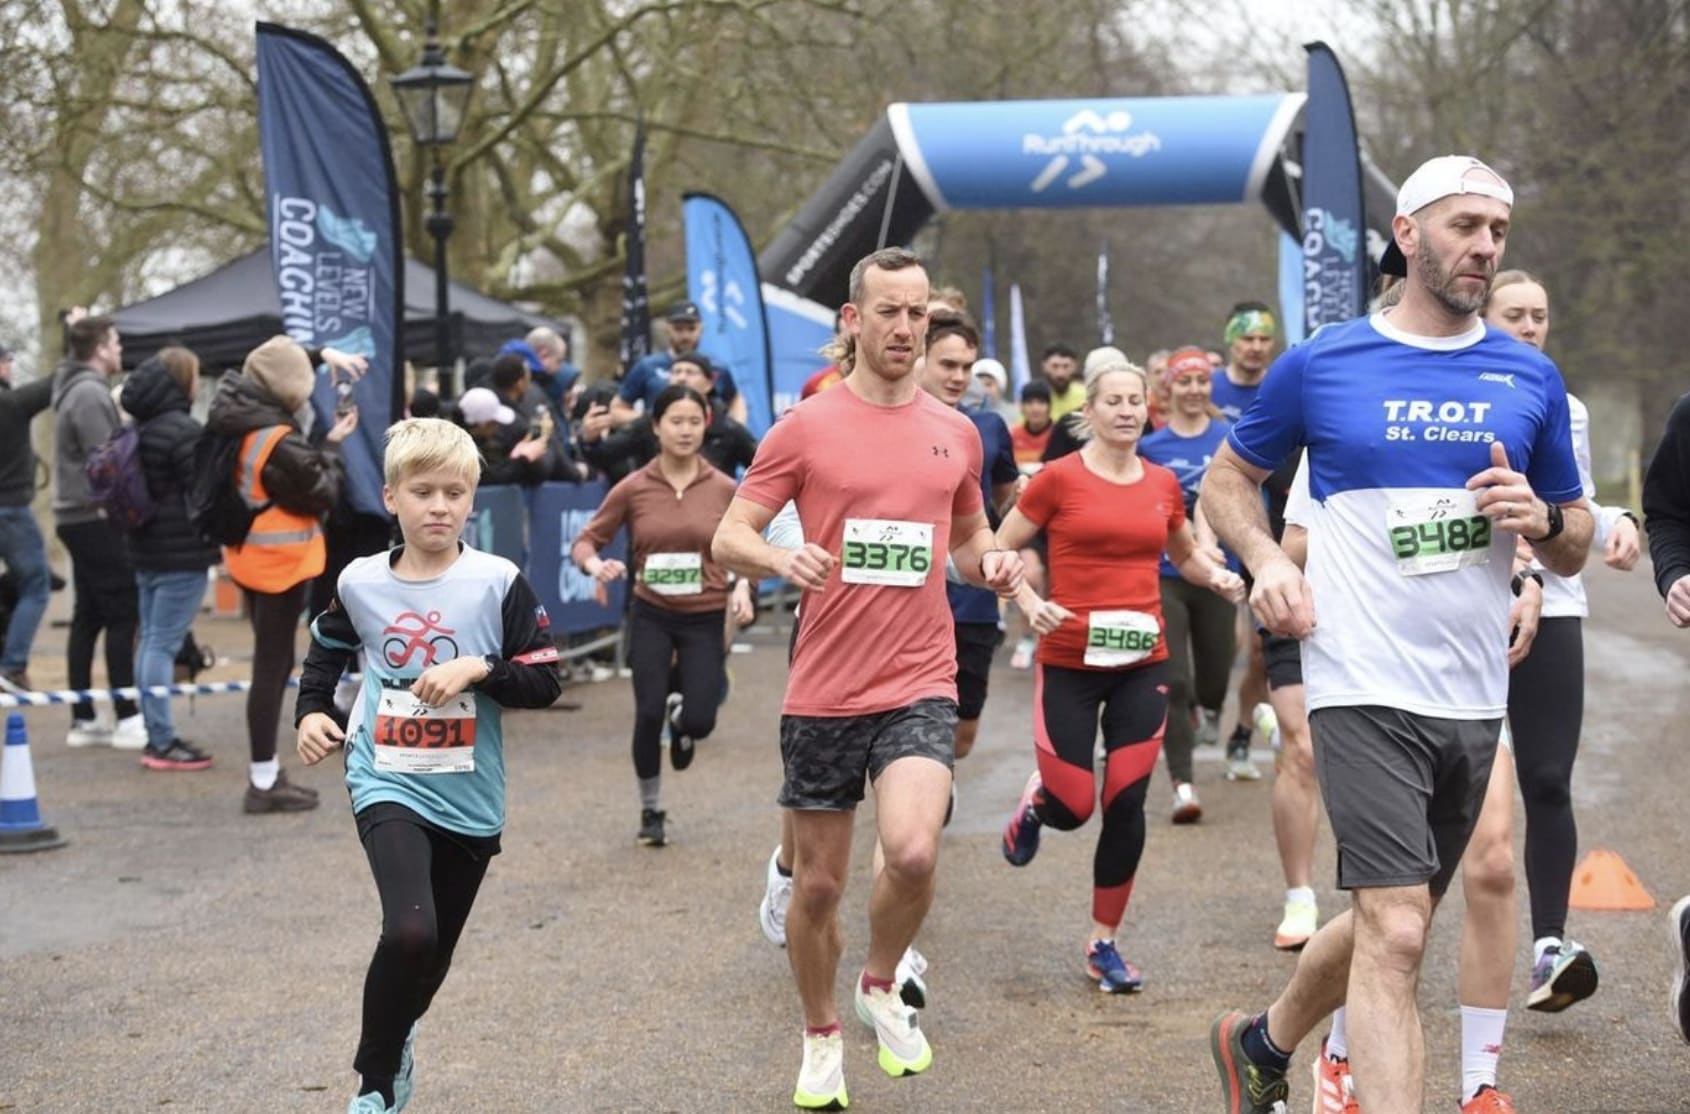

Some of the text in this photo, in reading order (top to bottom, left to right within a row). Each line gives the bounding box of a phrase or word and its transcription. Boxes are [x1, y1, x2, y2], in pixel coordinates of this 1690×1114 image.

[1023, 131, 1162, 158] RunThrough
[279, 197, 316, 348] COACHIN
[1303, 207, 1324, 329] COACH
[315, 252, 341, 333] LEVELS
[341, 268, 367, 321] NEW
[1321, 256, 1340, 324] LEVEL
[1383, 400, 1492, 424] T.R.O.T
[1385, 426, 1496, 444] St. Clears
[1391, 515, 1490, 559] 3482
[845, 541, 929, 573] 3376
[646, 567, 700, 585] 3297
[1089, 626, 1159, 651] 3486
[382, 717, 466, 748] 1091
